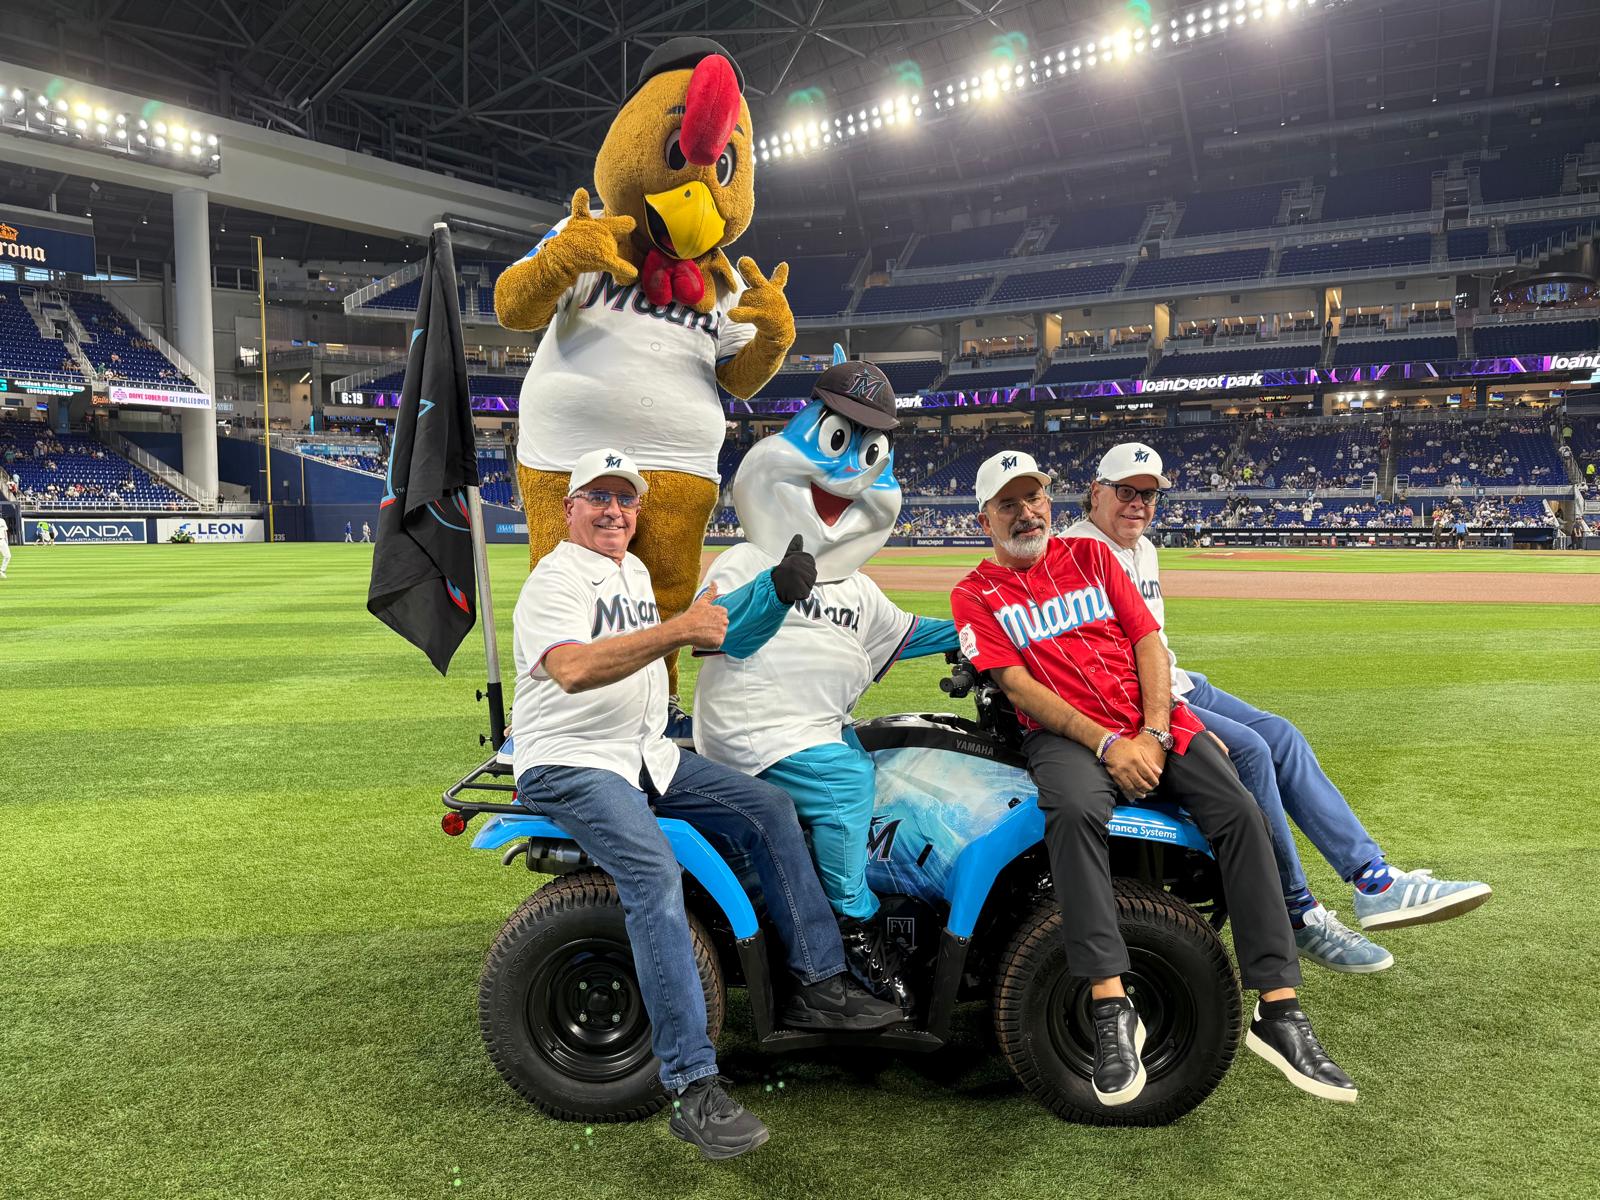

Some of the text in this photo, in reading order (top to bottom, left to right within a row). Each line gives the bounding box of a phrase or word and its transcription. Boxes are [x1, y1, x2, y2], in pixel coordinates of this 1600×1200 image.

[1141, 373, 1264, 393] loanDepot park
[128, 392, 144, 400] DRIVE
[144, 393, 161, 401] SOBER
[179, 396, 196, 405] PULLED
[197, 398, 210, 406] OVER
[341, 392, 363, 405] 6:19
[895, 395, 923, 409] park
[59, 525, 133, 537] VANDA
[198, 523, 244, 535] LEON
[956, 739, 994, 757] YAMAHA
[1140, 826, 1177, 839] Systems
